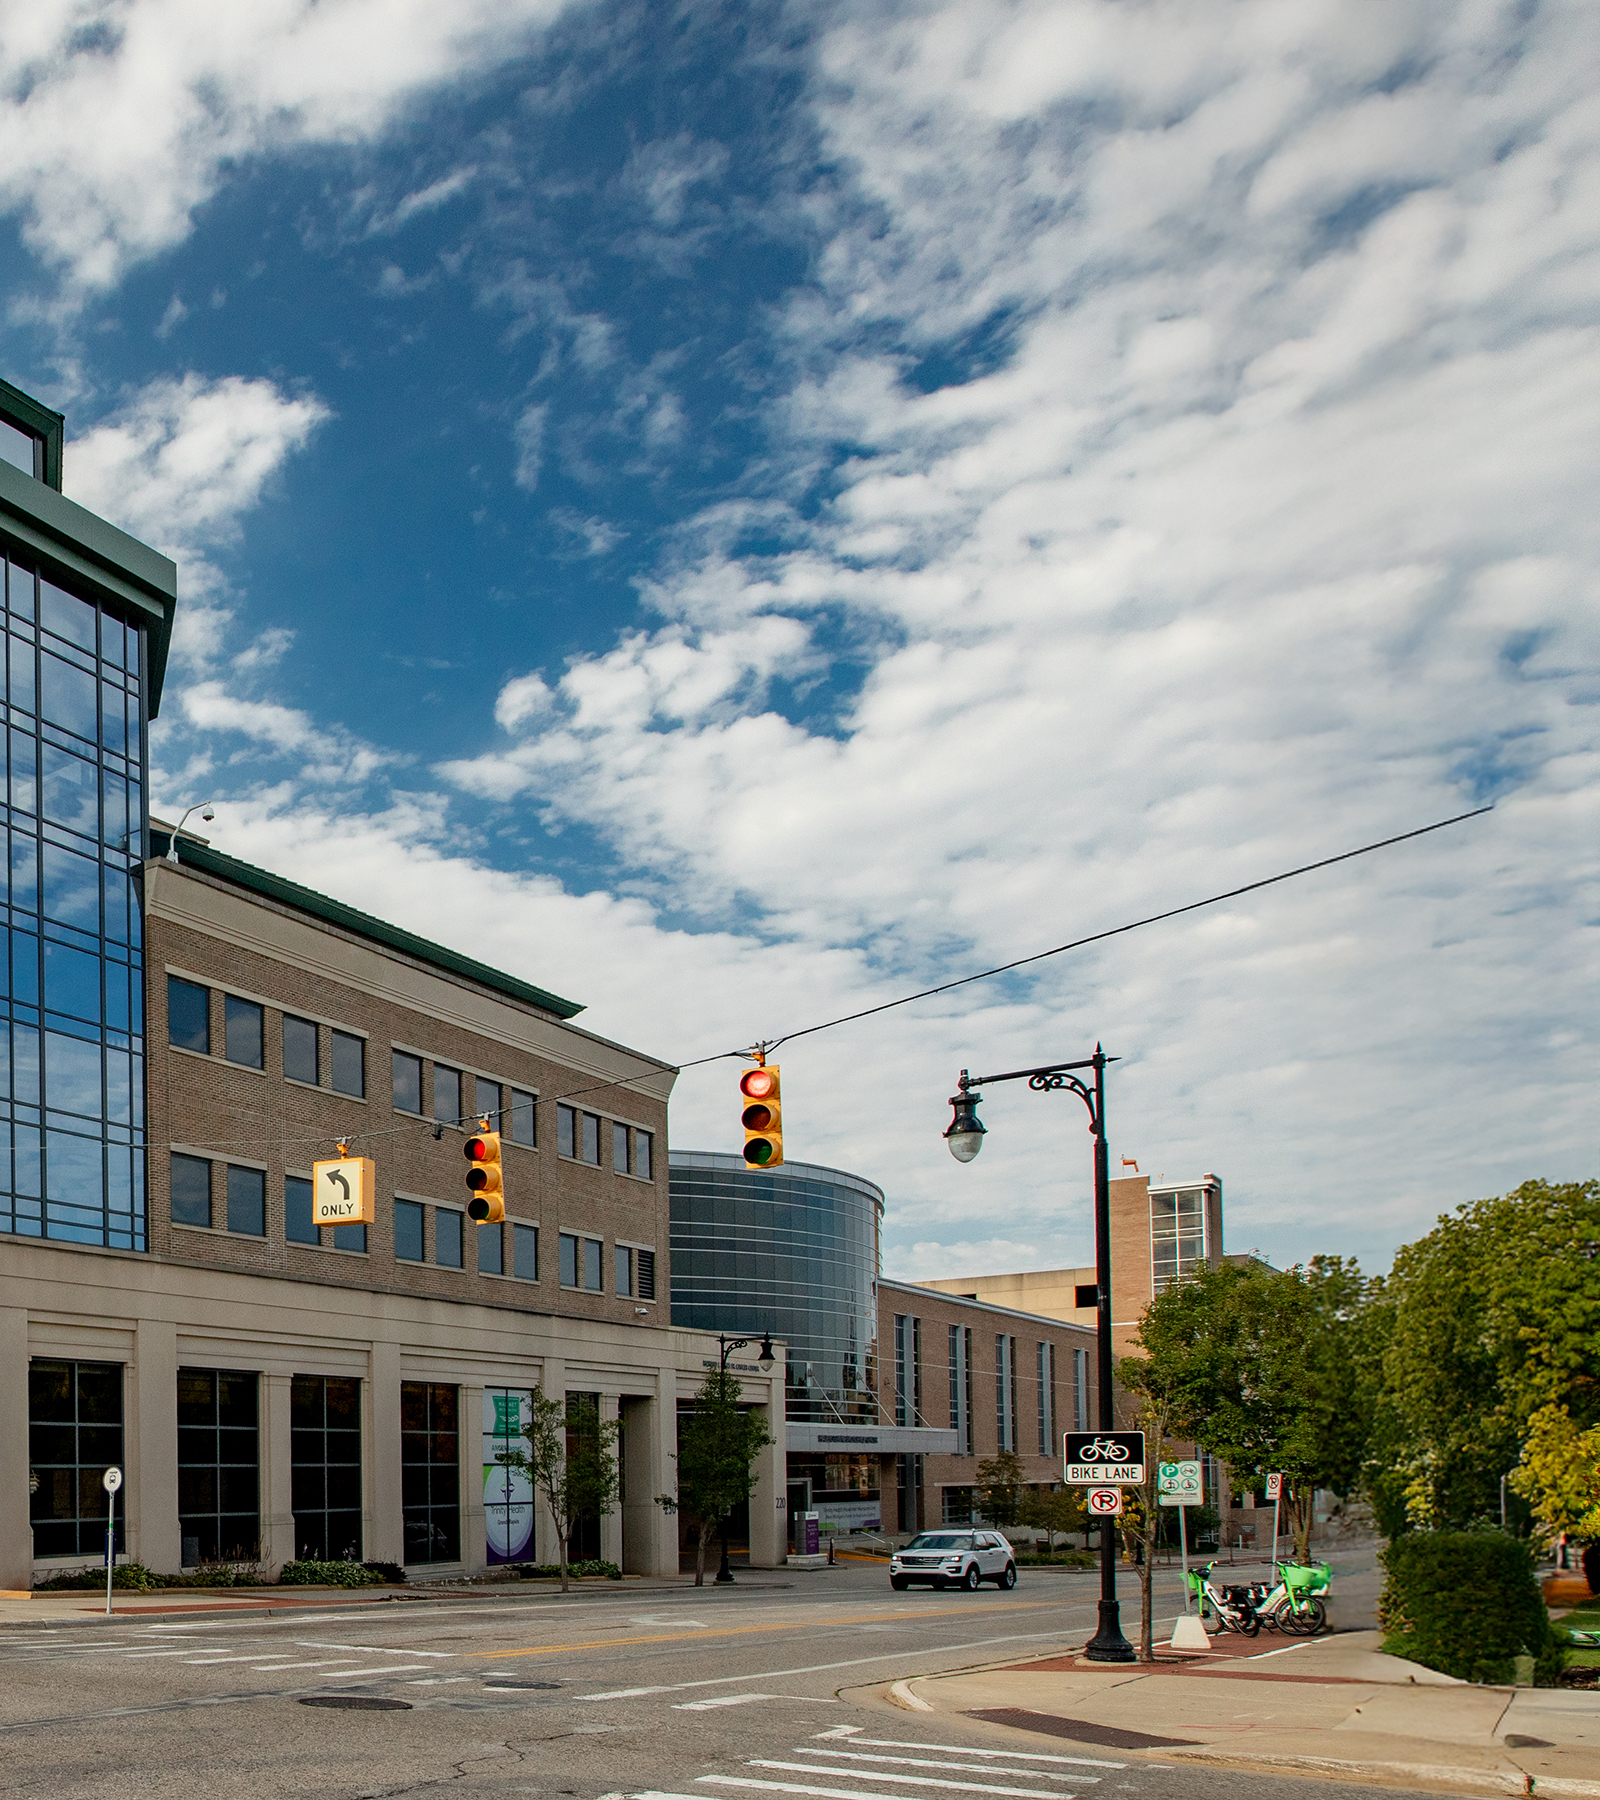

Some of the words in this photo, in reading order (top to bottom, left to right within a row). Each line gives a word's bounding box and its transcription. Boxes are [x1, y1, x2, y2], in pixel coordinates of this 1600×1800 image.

[321, 1203, 354, 1216] ONLY
[1071, 1467, 1099, 1479] BIKE
[1105, 1467, 1138, 1479] LANE
[775, 1497, 786, 1509] 220
[491, 1505, 507, 1516] Trinity
